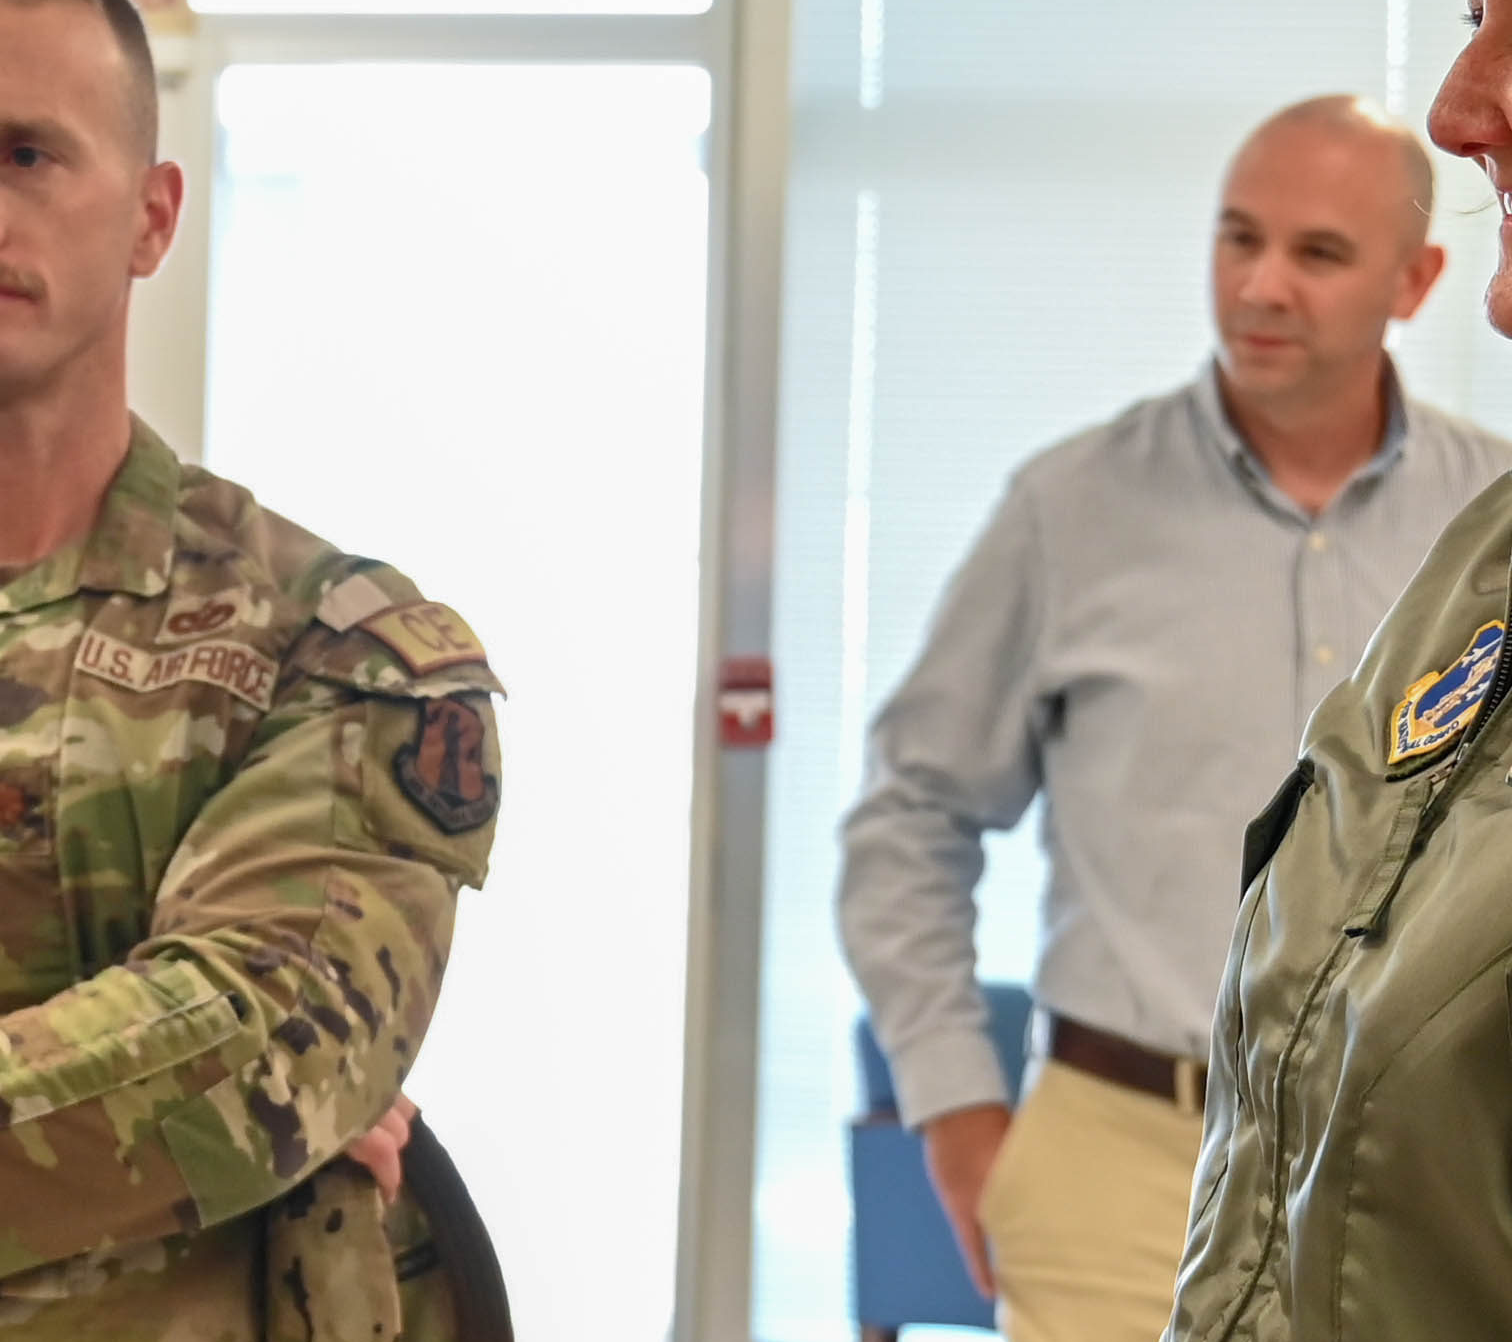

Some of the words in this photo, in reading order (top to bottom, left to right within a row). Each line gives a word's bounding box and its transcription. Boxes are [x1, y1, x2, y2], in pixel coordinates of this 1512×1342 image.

[400, 606, 473, 652] CE
[82, 633, 134, 684] U.S.
[187, 645, 273, 703] FORCE
